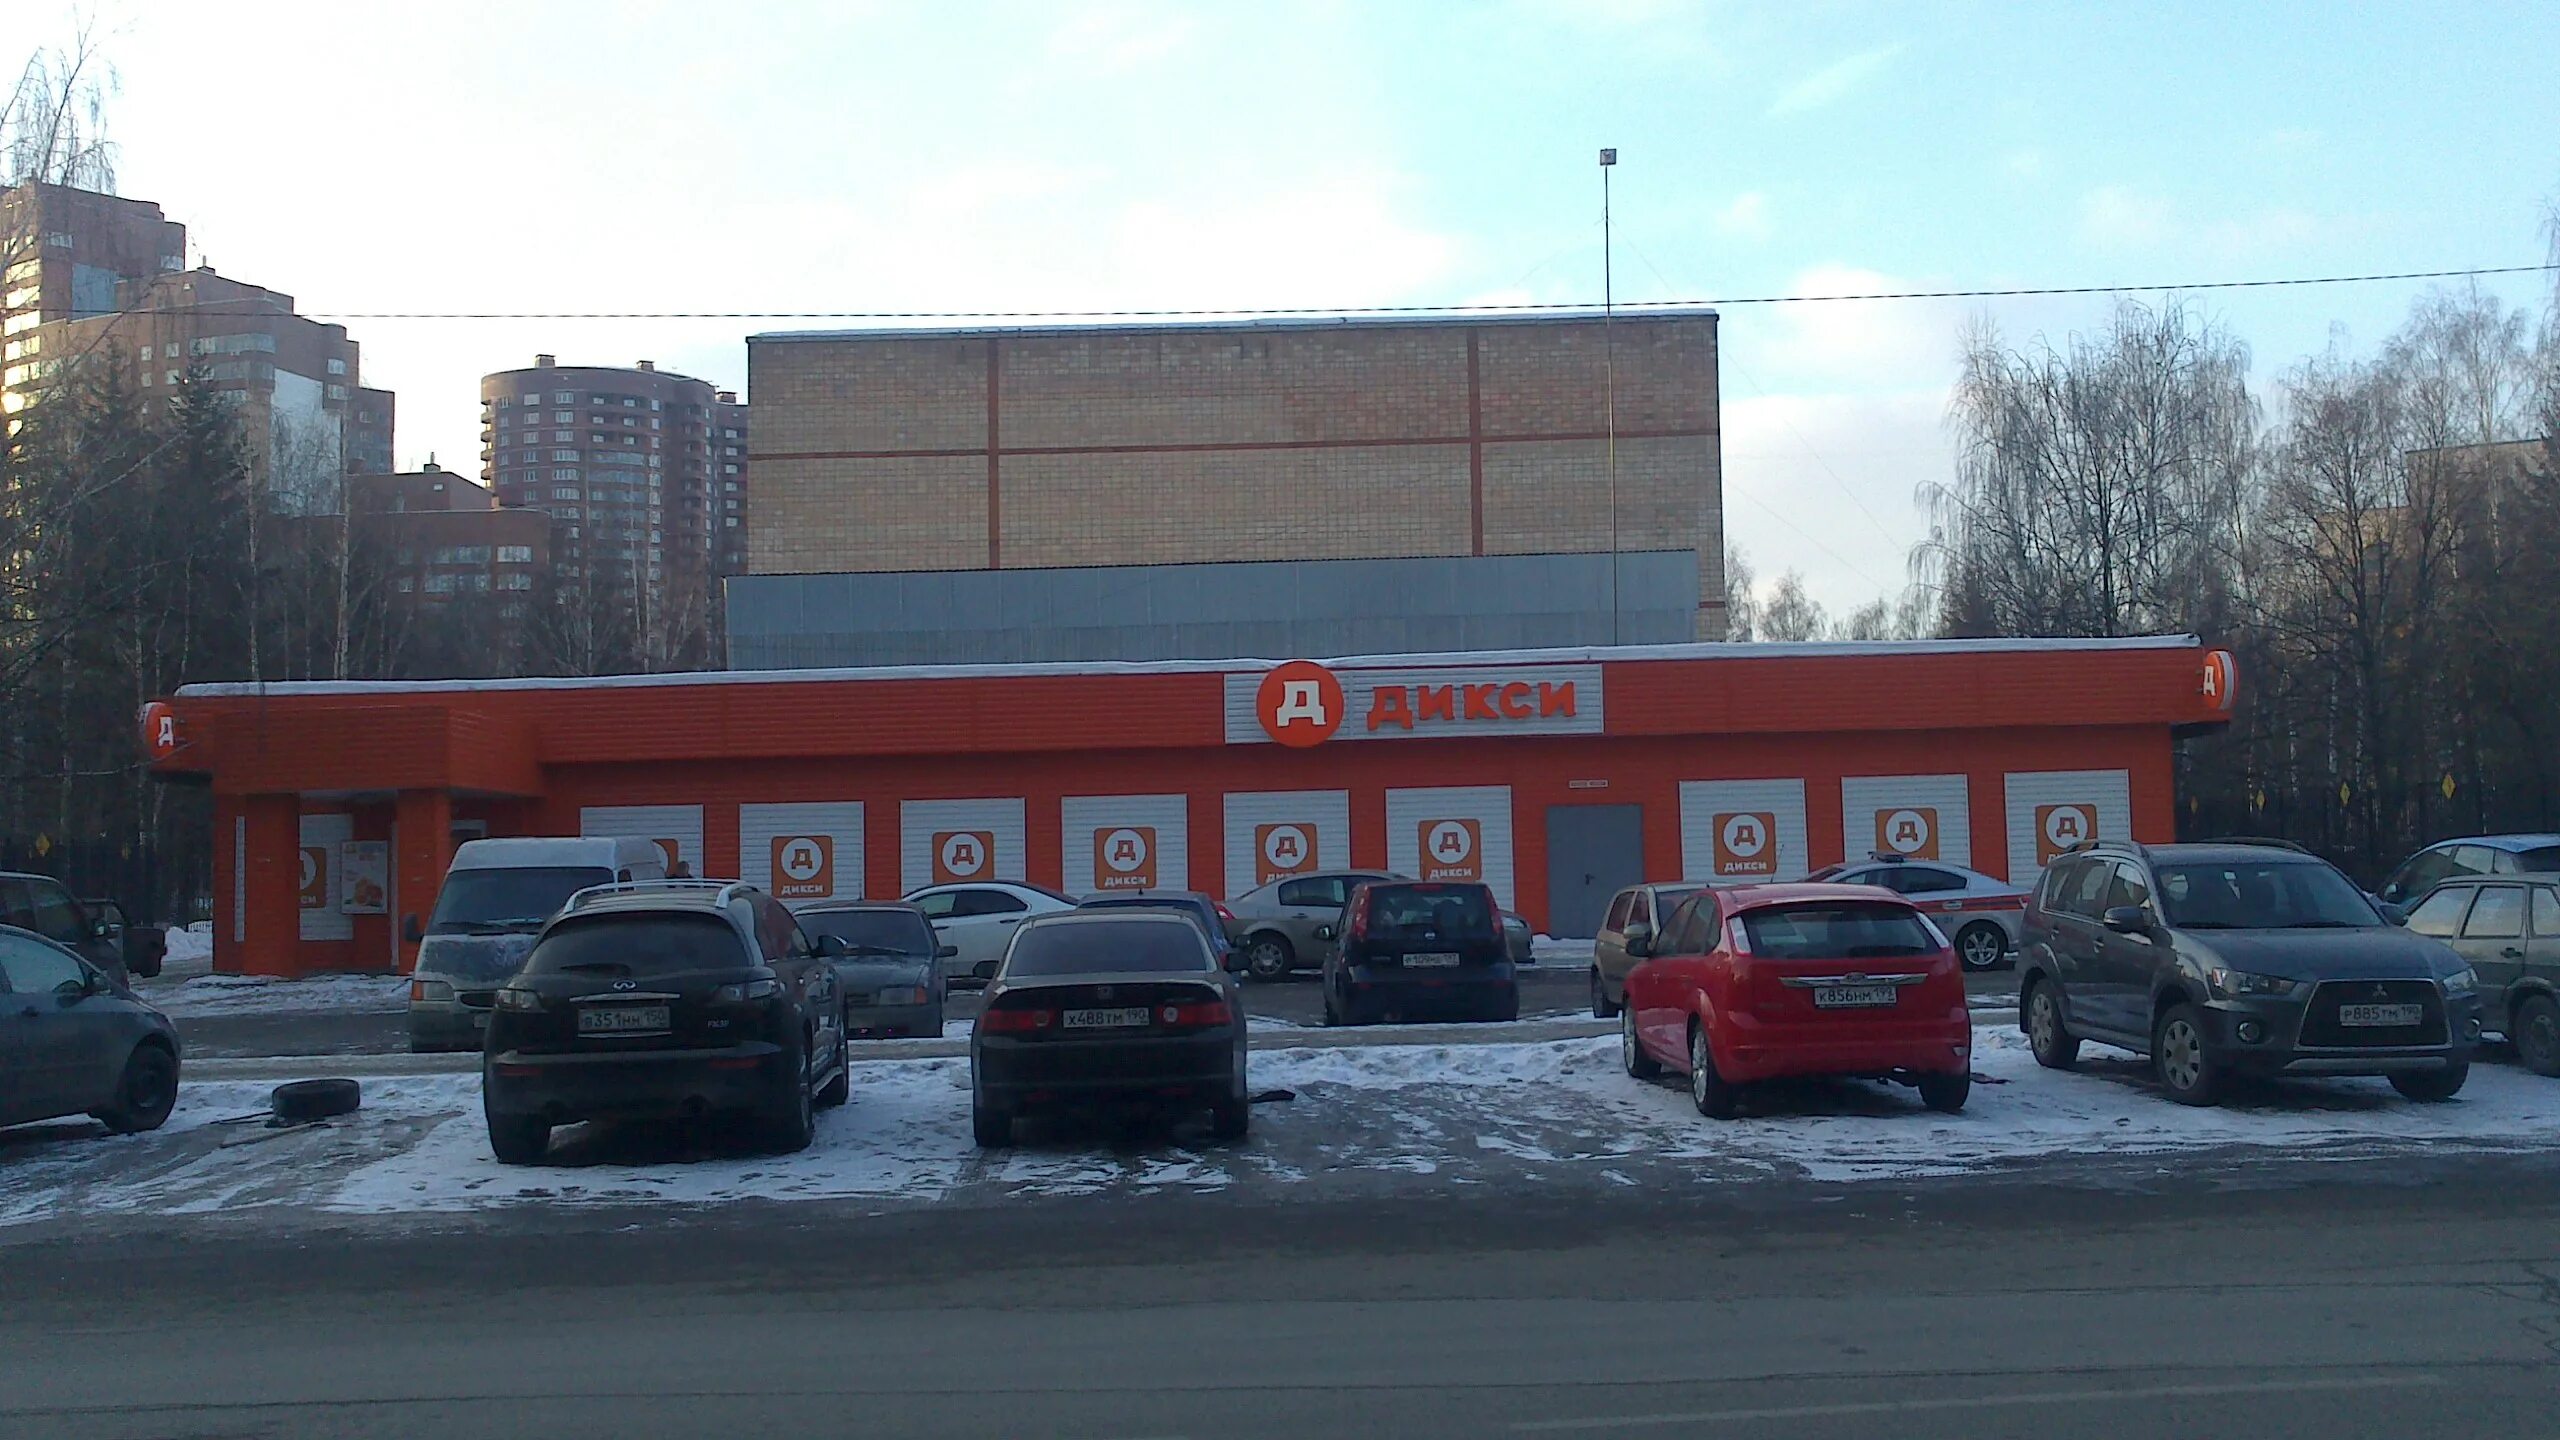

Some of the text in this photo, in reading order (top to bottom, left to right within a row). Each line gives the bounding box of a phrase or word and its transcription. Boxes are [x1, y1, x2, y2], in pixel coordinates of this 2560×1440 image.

[2203, 665, 2216, 696] Д
[1276, 680, 1577, 731] Д ДИКСИ
[158, 716, 174, 746] Д
[1734, 825, 1756, 846] Д
[1896, 821, 1918, 842] Д
[2056, 816, 2078, 837] Д
[1114, 839, 1136, 861] Д
[1276, 836, 1297, 857] Д
[1439, 832, 1461, 853] Д
[792, 848, 813, 869] Д
[952, 844, 975, 865] Д
[1430, 868, 1472, 879] ДИКСИ
[1724, 861, 1767, 872] ДИКСИ
[781, 884, 824, 895] ДИКСИ
[1105, 876, 1146, 887] ДИКСИ
